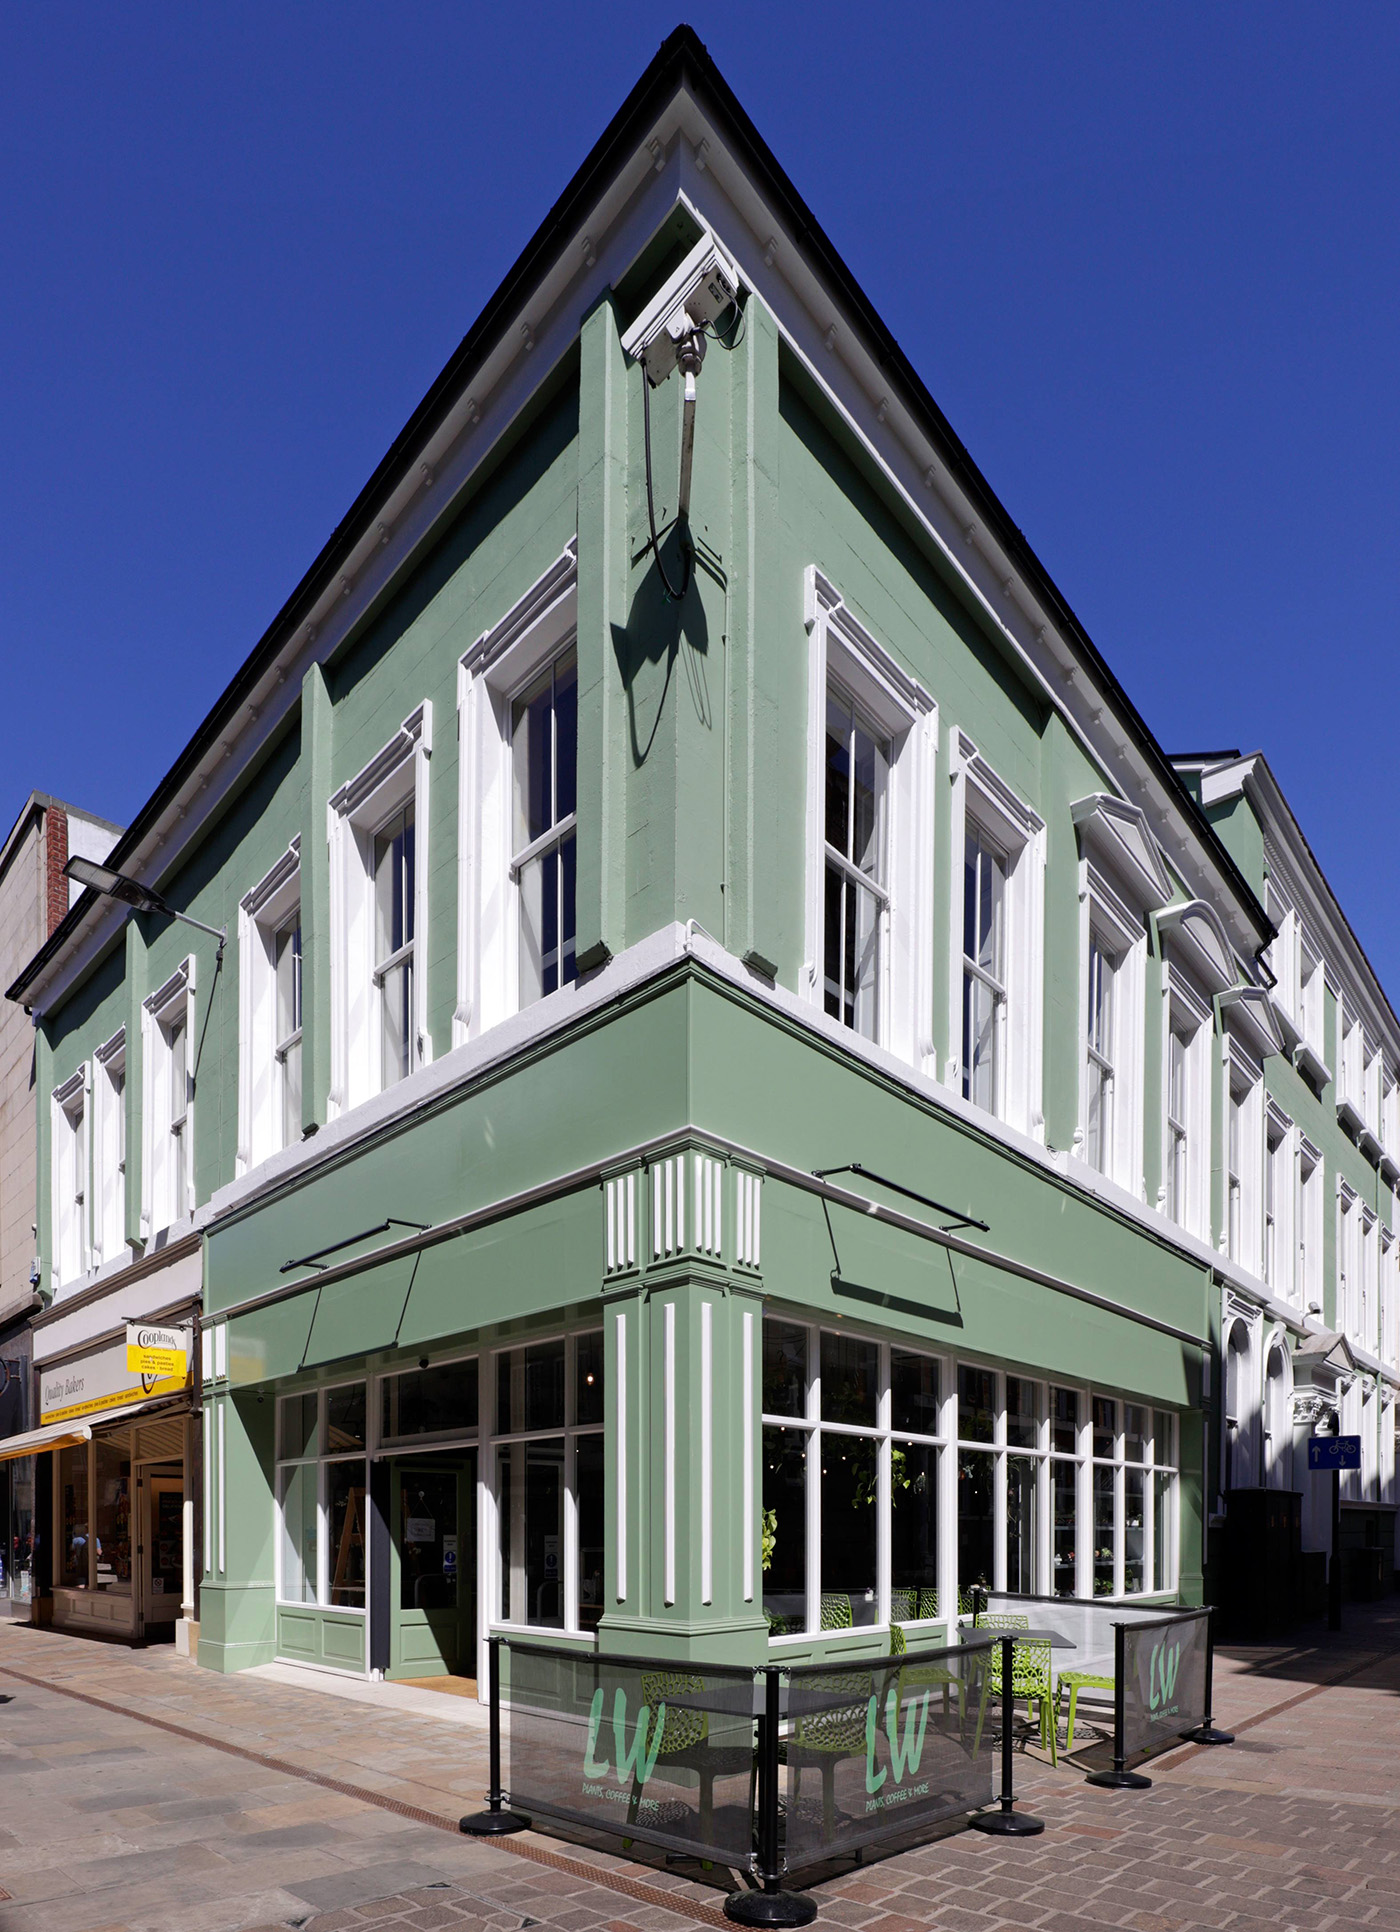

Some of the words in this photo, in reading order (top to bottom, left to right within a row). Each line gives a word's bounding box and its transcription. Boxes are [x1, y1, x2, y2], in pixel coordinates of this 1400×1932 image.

[138, 1330, 177, 1351] Cooplands
[45, 1381, 64, 1406] Quality
[65, 1375, 84, 1396] Bakers
[1149, 1641, 1180, 1711] LW
[583, 1687, 666, 1785] LW
[865, 1688, 930, 1794] LW
[605, 1788, 631, 1804] COFFEE
[631, 1795, 638, 1805] &
[639, 1796, 660, 1812] MORE
[885, 1788, 908, 1805] COFFEE
[913, 1782, 930, 1797] MORE
